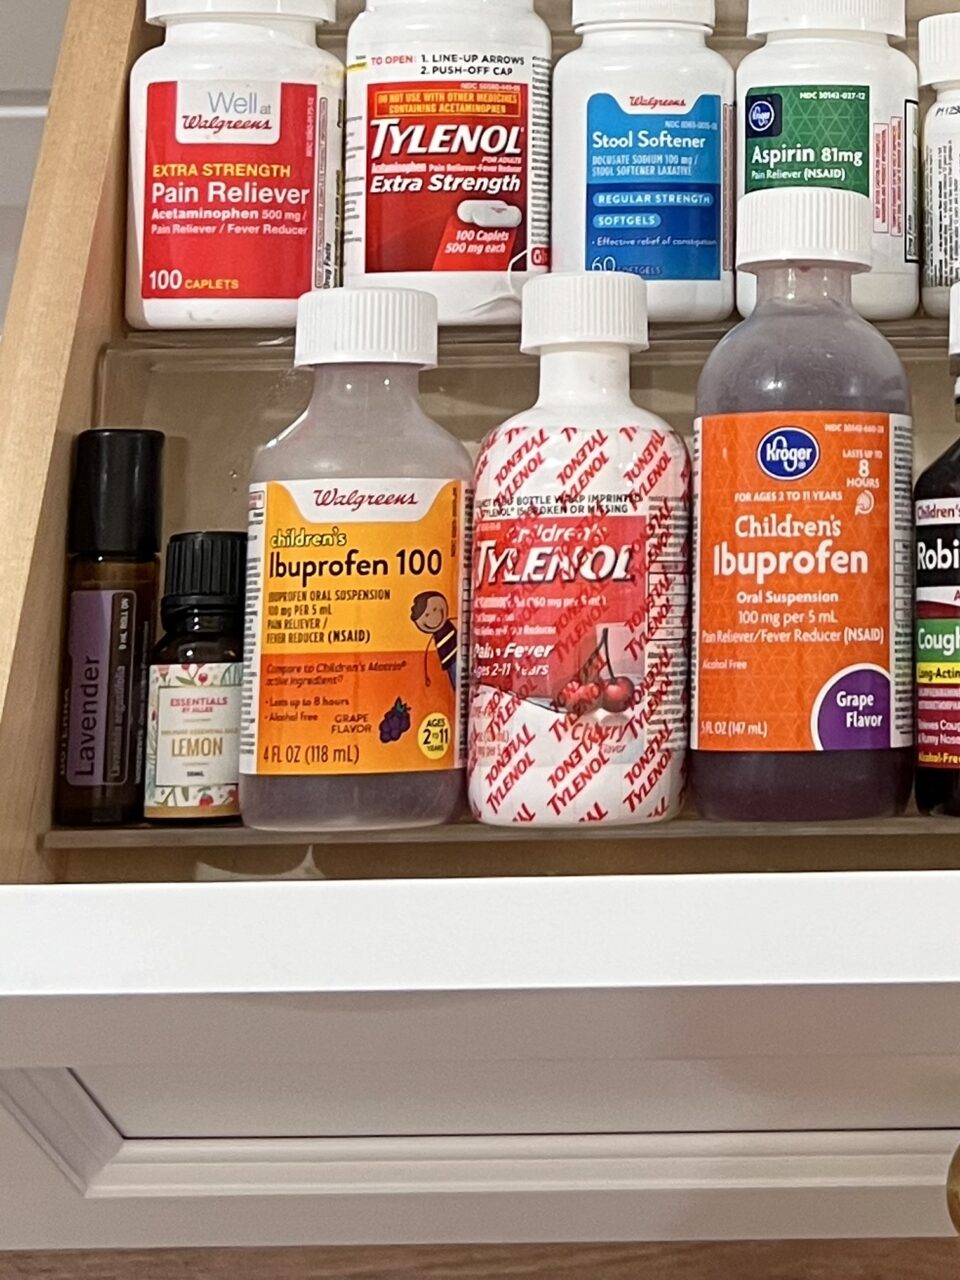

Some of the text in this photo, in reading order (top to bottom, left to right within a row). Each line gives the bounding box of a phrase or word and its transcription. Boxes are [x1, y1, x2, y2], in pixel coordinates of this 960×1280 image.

[208, 92, 271, 114] Well at
[182, 115, 272, 134] Walgreens
[370, 118, 521, 159] TYLENOL
[592, 131, 705, 148] Stool Softener
[752, 144, 862, 168] Aspirin 81mg
[153, 164, 290, 178] EXTRA STRENGTH
[152, 182, 310, 204] Pain Reliever
[370, 174, 521, 194] Extra Strength
[598, 194, 710, 204] REGULAR STRENGTH
[152, 208, 301, 223] Acetaminophen 500 mg
[598, 216, 655, 225] SOFTGELS
[456, 230, 509, 242] 100 Caplets
[445, 243, 506, 254] 500 mg each
[149, 269, 239, 290] 100 CAPLETS
[766, 436, 812, 471] Kroger
[859, 459, 870, 477] 8
[847, 478, 879, 488] HOURS
[313, 488, 418, 510] Walgreens
[735, 514, 841, 537] Children's
[270, 528, 346, 547] children's
[269, 549, 441, 586] Ibuprofen 100
[714, 541, 868, 584] Ibuprofen
[737, 591, 838, 606] Oral Suspension
[738, 611, 837, 626] 100 mg per 5 mL
[170, 697, 228, 707] ESSENTIALS
[836, 691, 874, 708] Grape
[75, 655, 100, 776] Lavender
[334, 714, 369, 723] GRAPE
[846, 712, 882, 727] Flavor
[331, 724, 371, 734] FLAVOR
[171, 737, 224, 757] LEMON
[263, 746, 359, 765] 4 FL OZ (118 mL)
[486, 753, 535, 814] TYLENOL
[547, 751, 609, 815] TYLENOL
